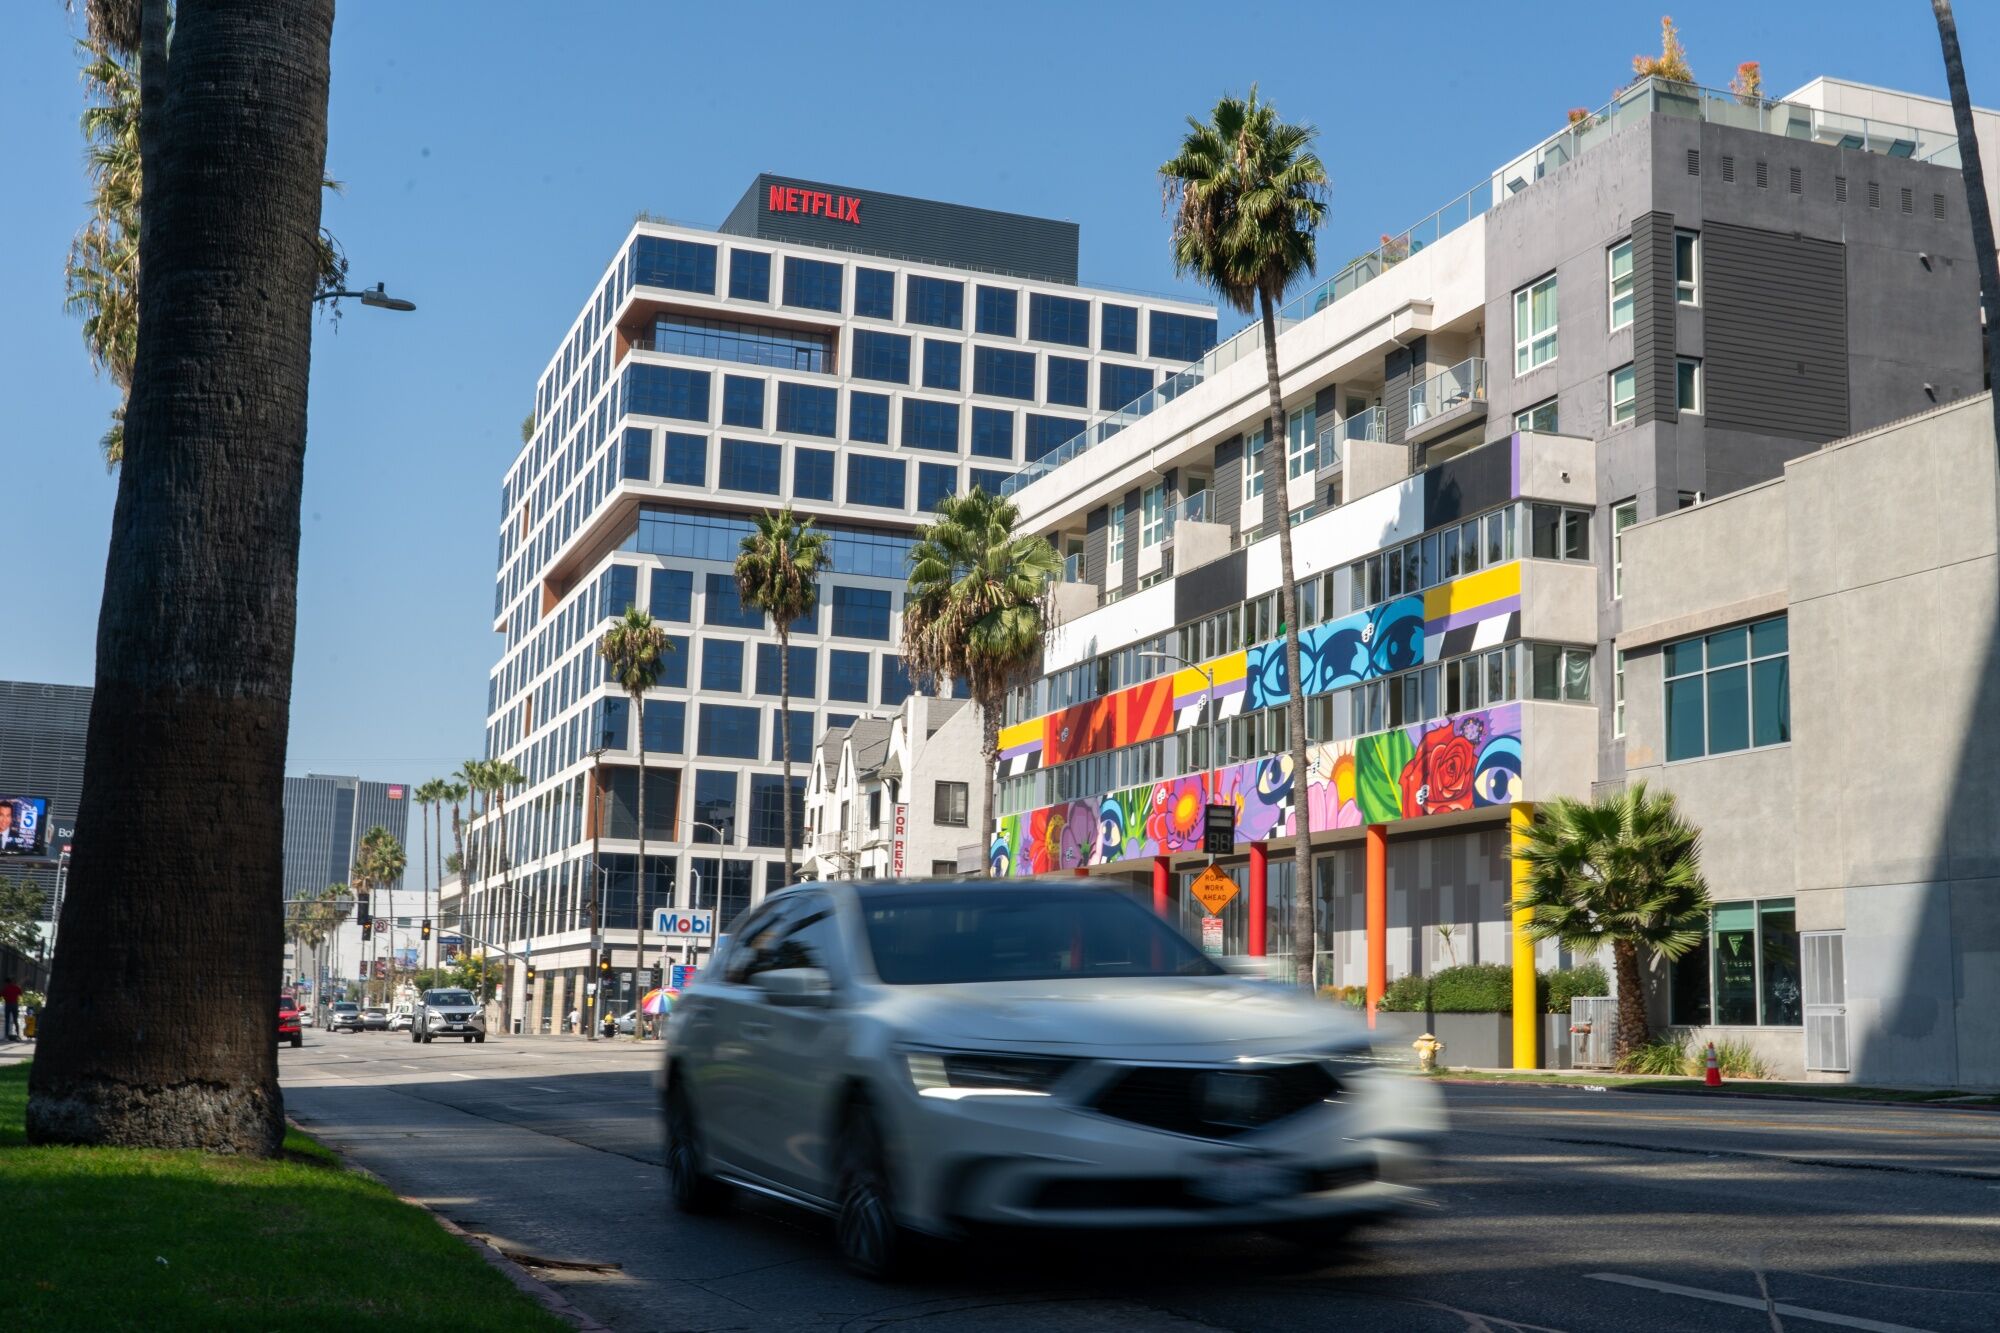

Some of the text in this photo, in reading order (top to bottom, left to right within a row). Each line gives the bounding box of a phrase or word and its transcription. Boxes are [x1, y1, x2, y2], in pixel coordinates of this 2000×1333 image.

[769, 185, 860, 224] NETFLIX
[23, 812, 34, 828] 5
[894, 806, 905, 878] FOR RENT
[1204, 874, 1224, 882] ROAD
[1204, 884, 1225, 892] WORK
[659, 913, 711, 934] Mobi
